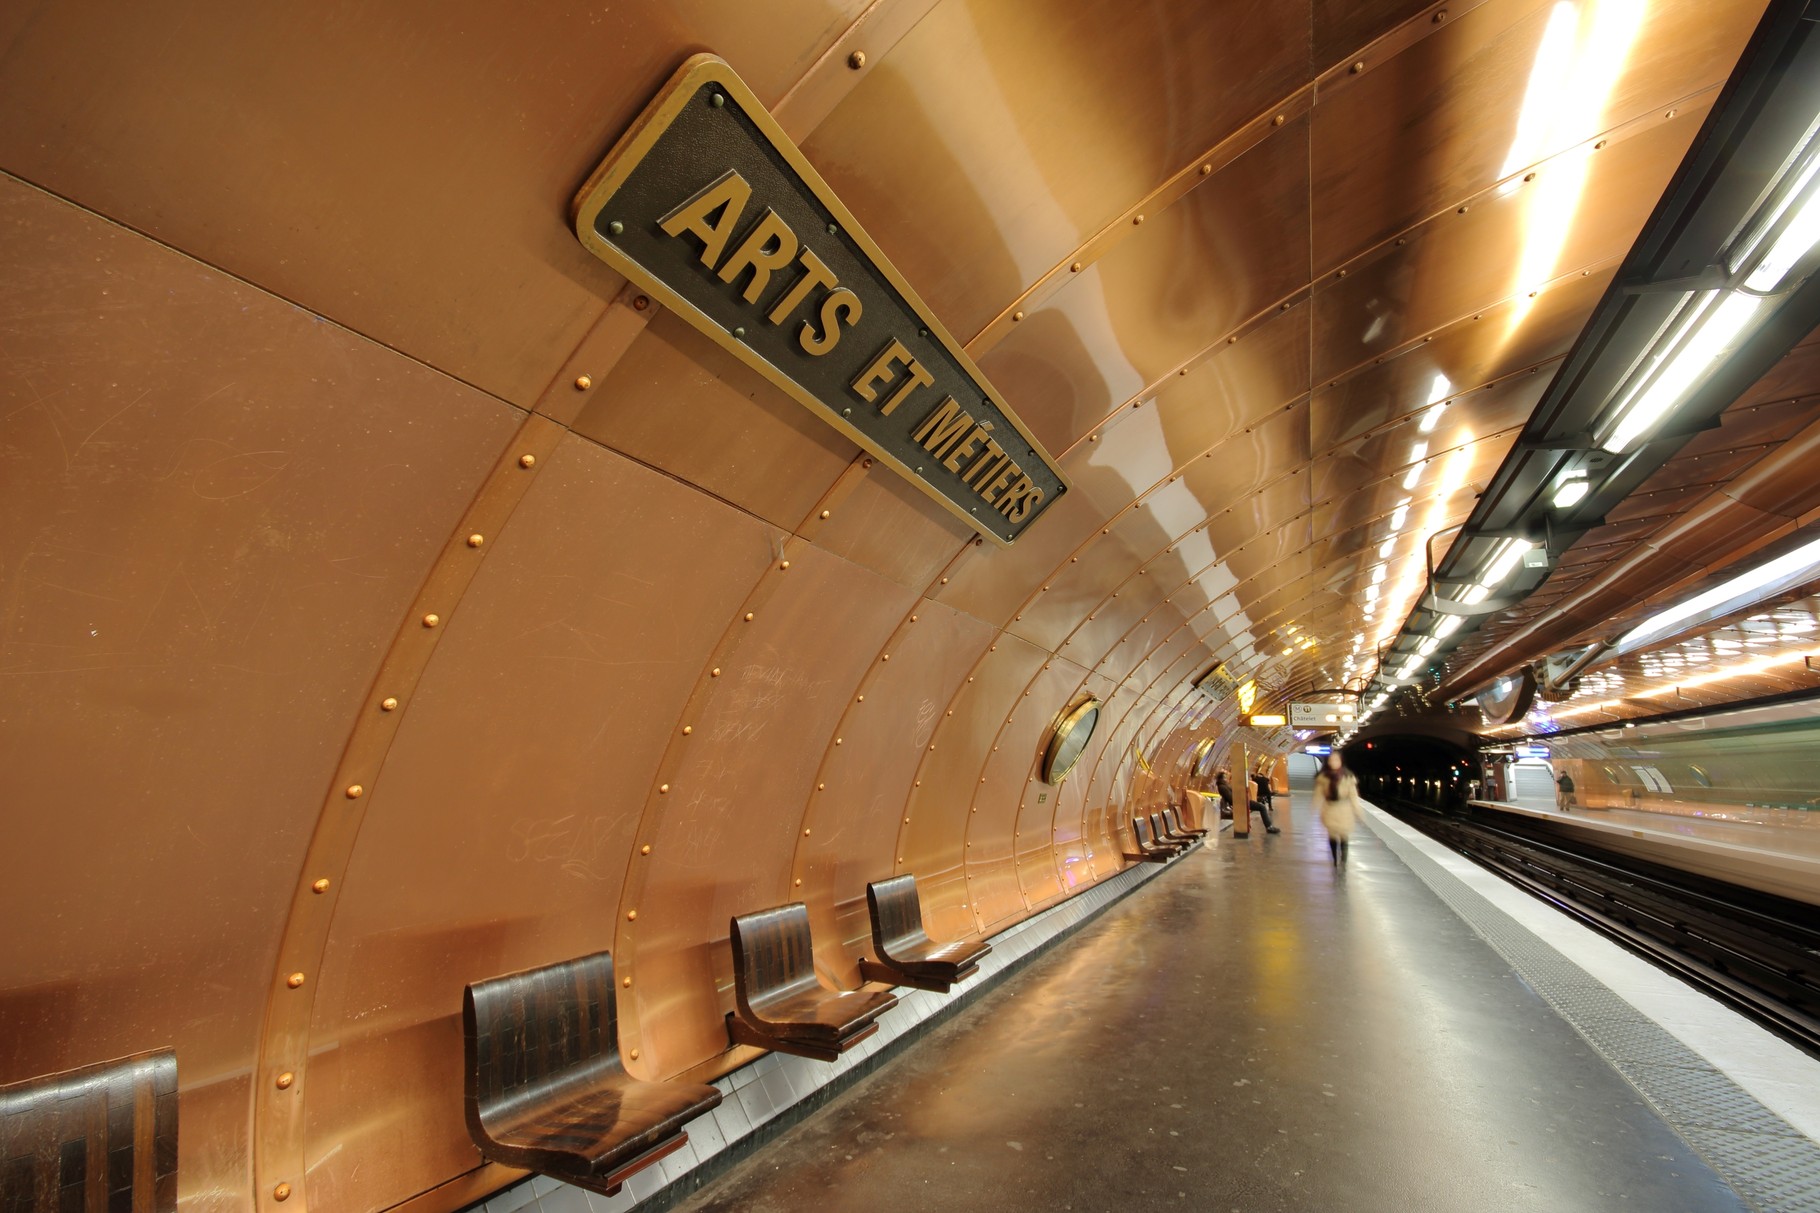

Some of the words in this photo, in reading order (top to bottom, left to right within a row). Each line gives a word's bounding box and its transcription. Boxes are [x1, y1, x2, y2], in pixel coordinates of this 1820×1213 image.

[656, 169, 863, 357] ARTS
[850, 337, 935, 417] ET
[910, 394, 1045, 524] MÉTIERS
